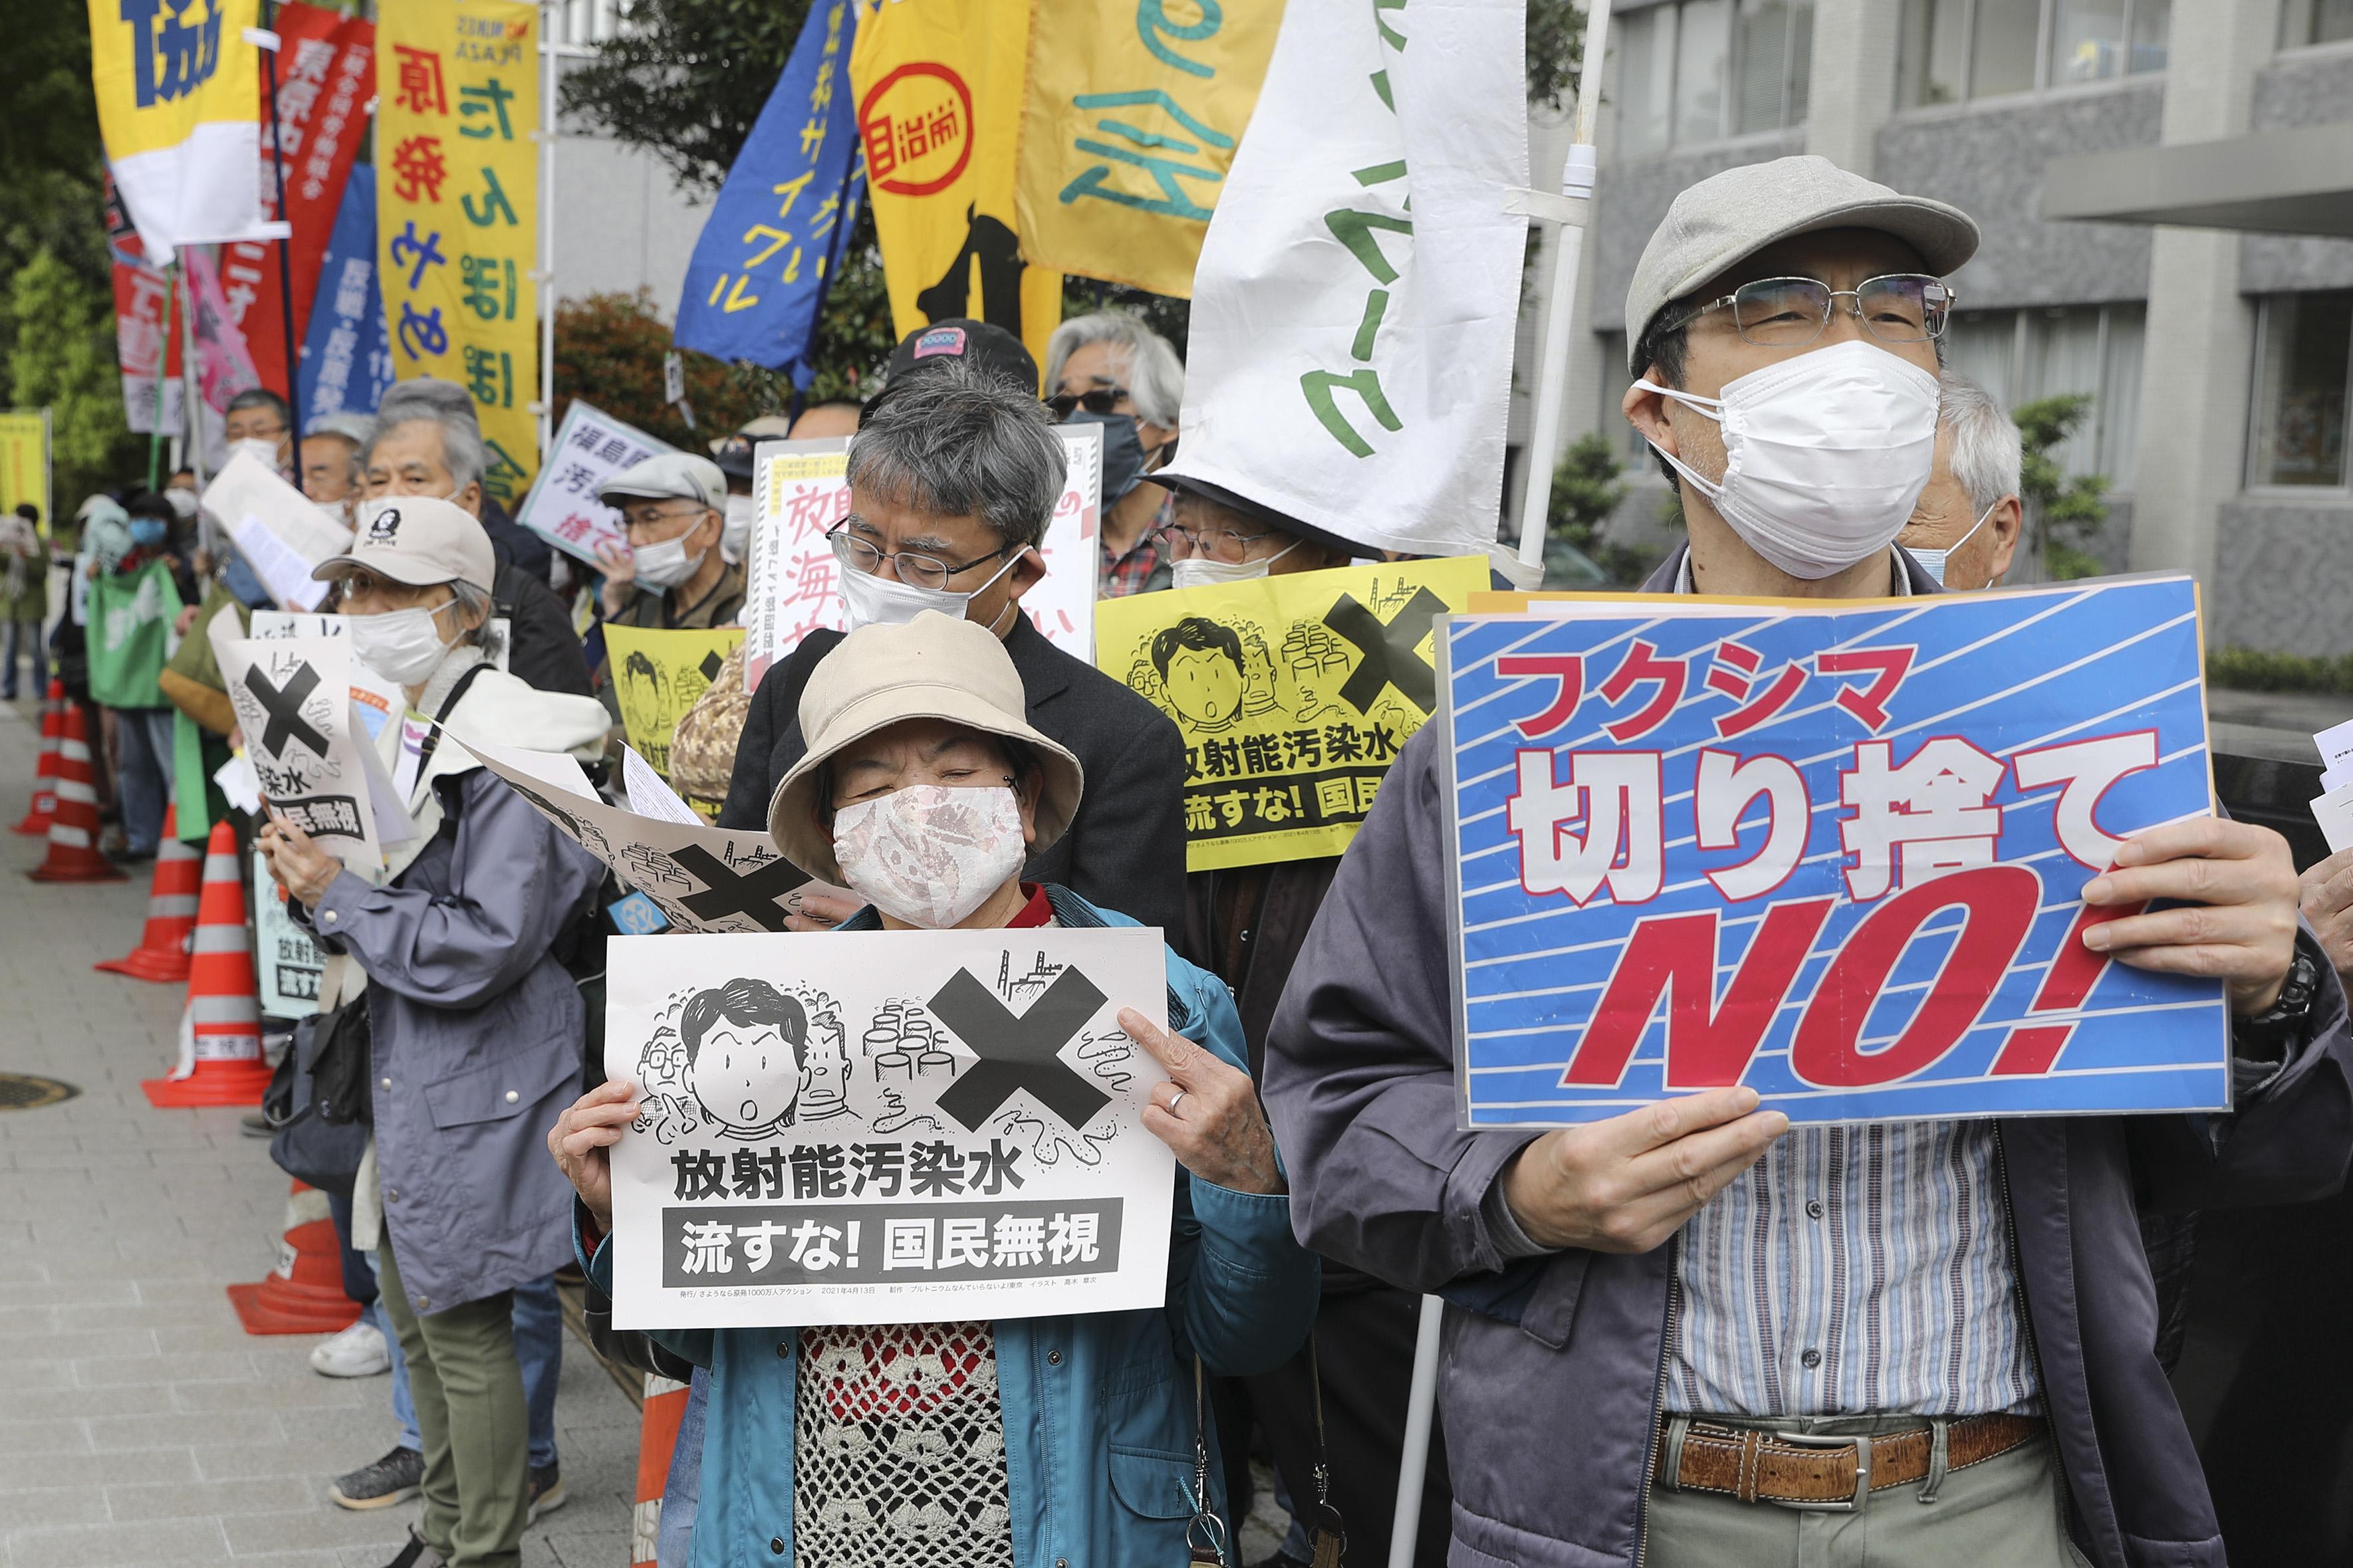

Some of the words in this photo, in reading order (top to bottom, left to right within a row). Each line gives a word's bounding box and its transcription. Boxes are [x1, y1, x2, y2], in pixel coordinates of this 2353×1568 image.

[1493, 639, 1918, 742] フクシマ
[1506, 728, 2159, 907] 切り捨て
[1558, 860, 2149, 1091] NO!
[670, 1139, 1026, 1201] 放射能汚染水
[680, 1220, 860, 1276] 流すな!
[882, 1212, 1100, 1271] 国民無視
